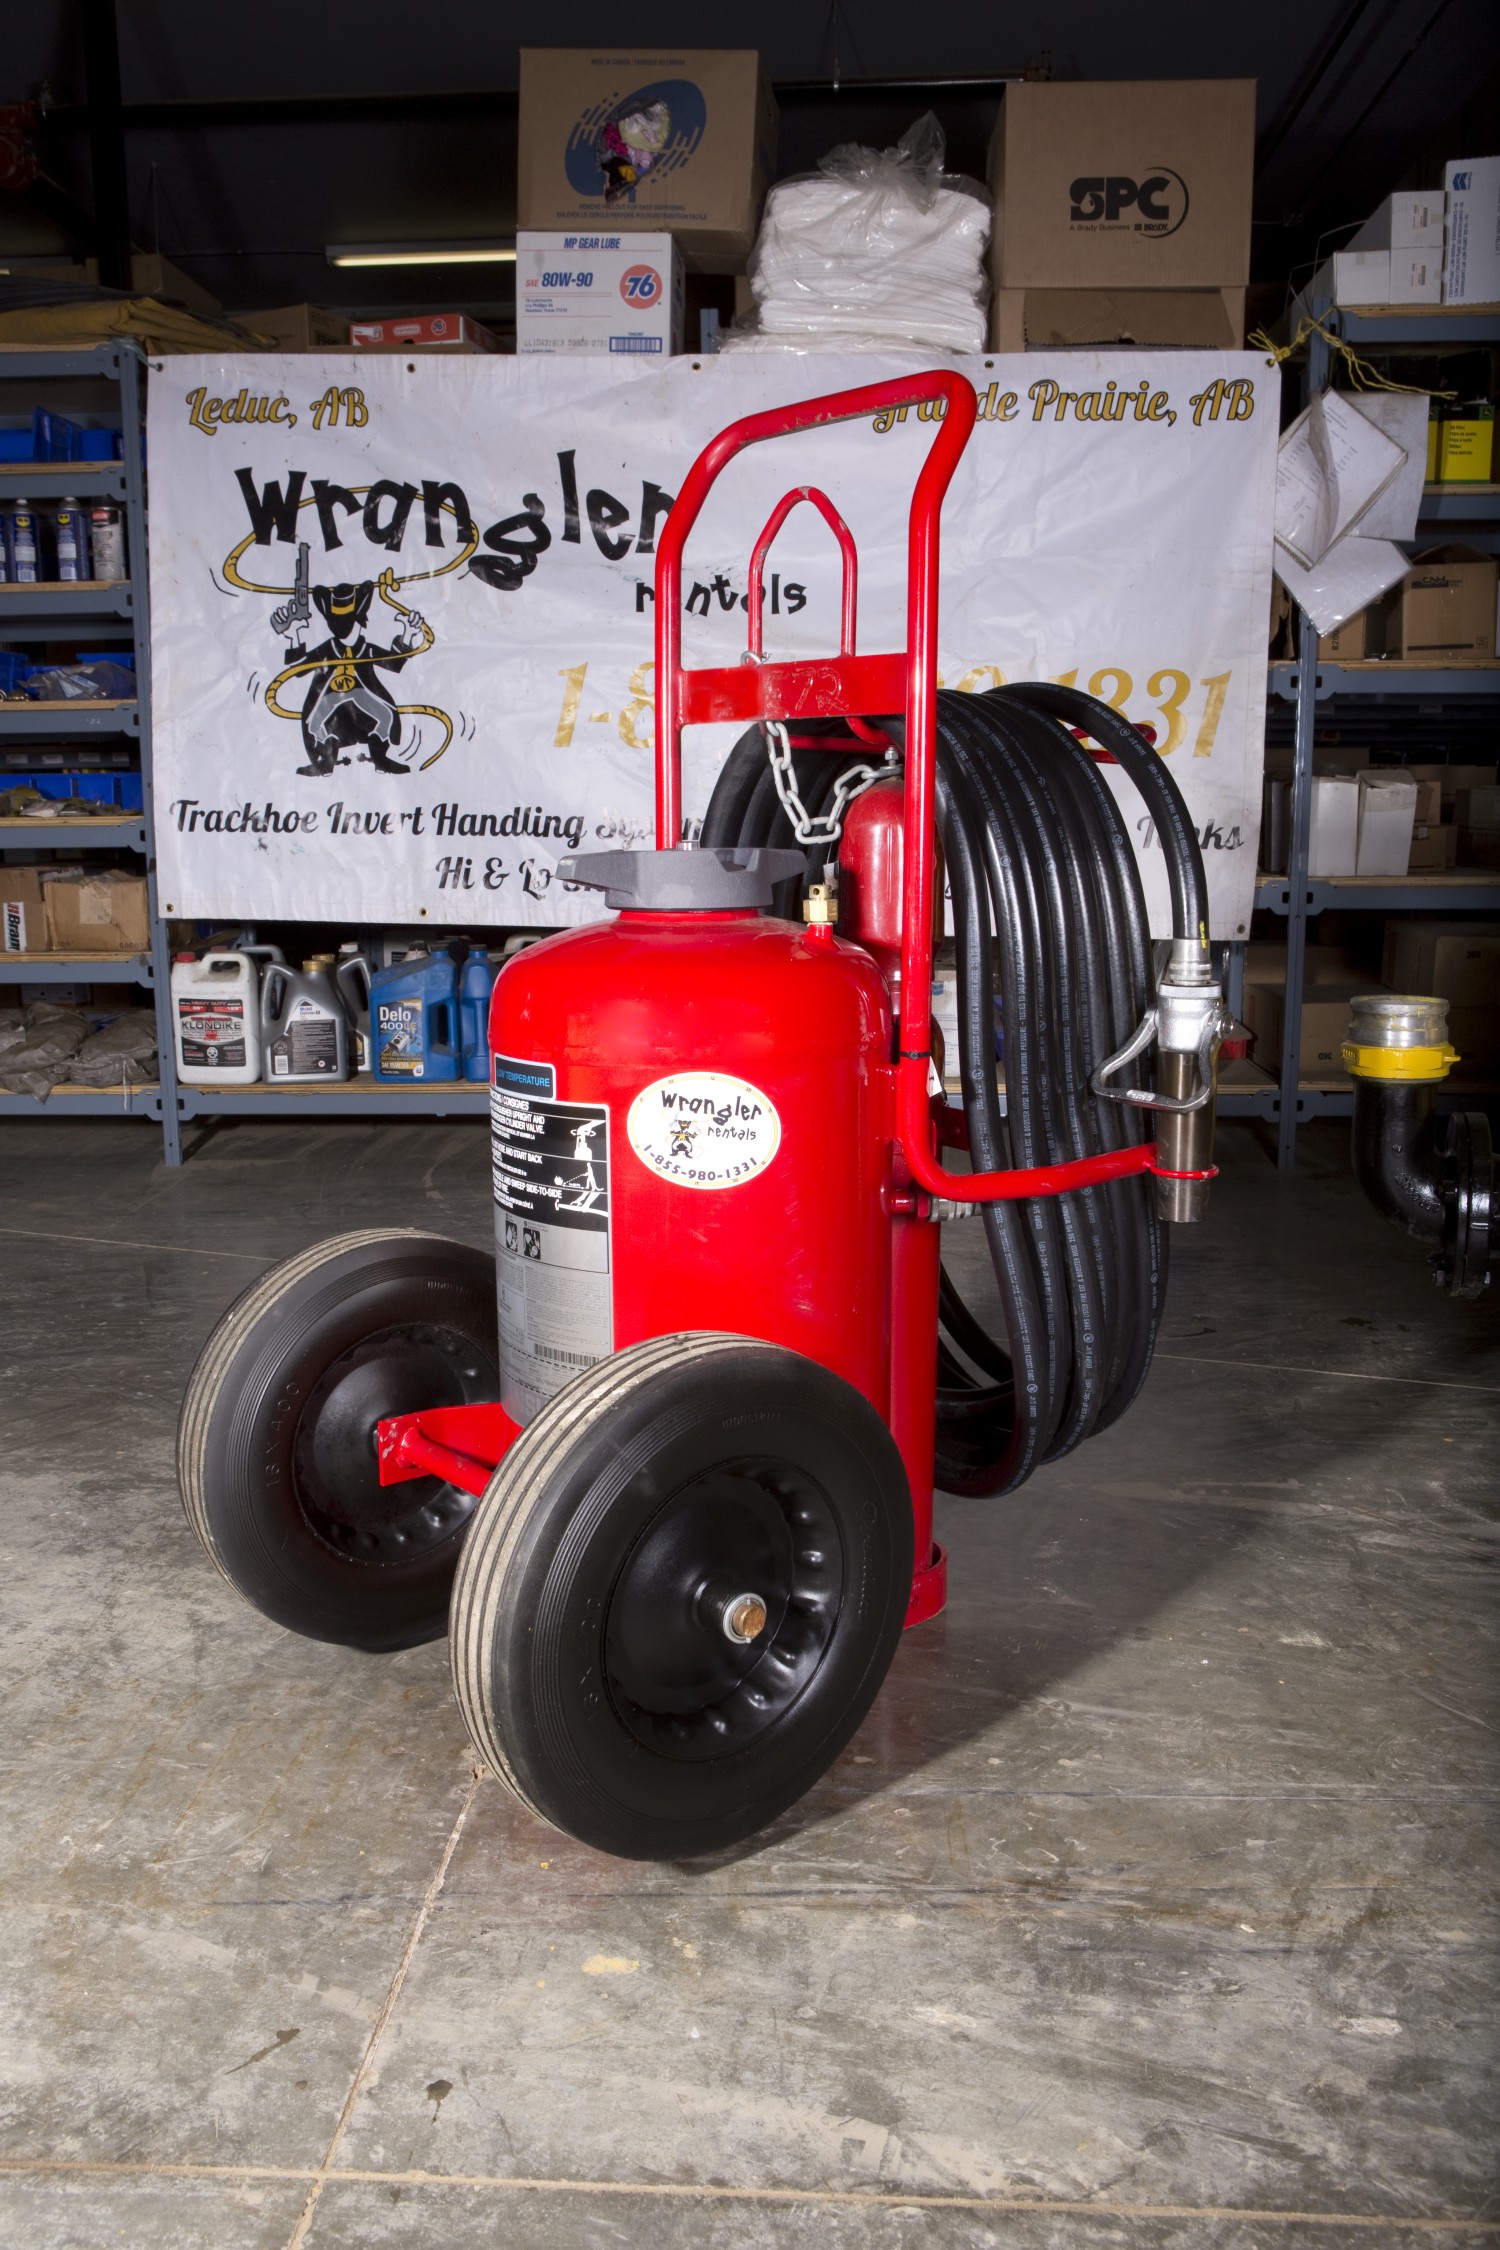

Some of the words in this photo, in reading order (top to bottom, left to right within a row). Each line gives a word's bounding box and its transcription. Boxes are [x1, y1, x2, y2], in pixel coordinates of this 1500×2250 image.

[1069, 176, 1170, 220] SPC
[564, 237, 577, 249] MP
[578, 237, 600, 249] GEAR
[600, 237, 621, 249] LUBE
[525, 279, 539, 288] SAE
[541, 272, 594, 288] 80W-90
[625, 273, 657, 299] 76
[185, 386, 298, 436] Leduc,
[309, 386, 370, 431] AB
[1028, 378, 1179, 429] Prairie,
[1189, 378, 1256, 429] AB
[168, 799, 319, 835] Trackhoe
[326, 801, 426, 837] Invert
[431, 802, 586, 849] Handling
[435, 856, 475, 890] Hi
[483, 858, 508, 889] &
[181, 1020, 242, 1030] KLONDIKE
[379, 1006, 411, 1022] Delo
[505, 1070, 550, 1088] TEMPERATURE
[707, 1126, 757, 1141] rentals
[643, 1144, 757, 1181] 1-855-980-1331
[525, 1182, 563, 1199] SIDE-TO-SIDE
